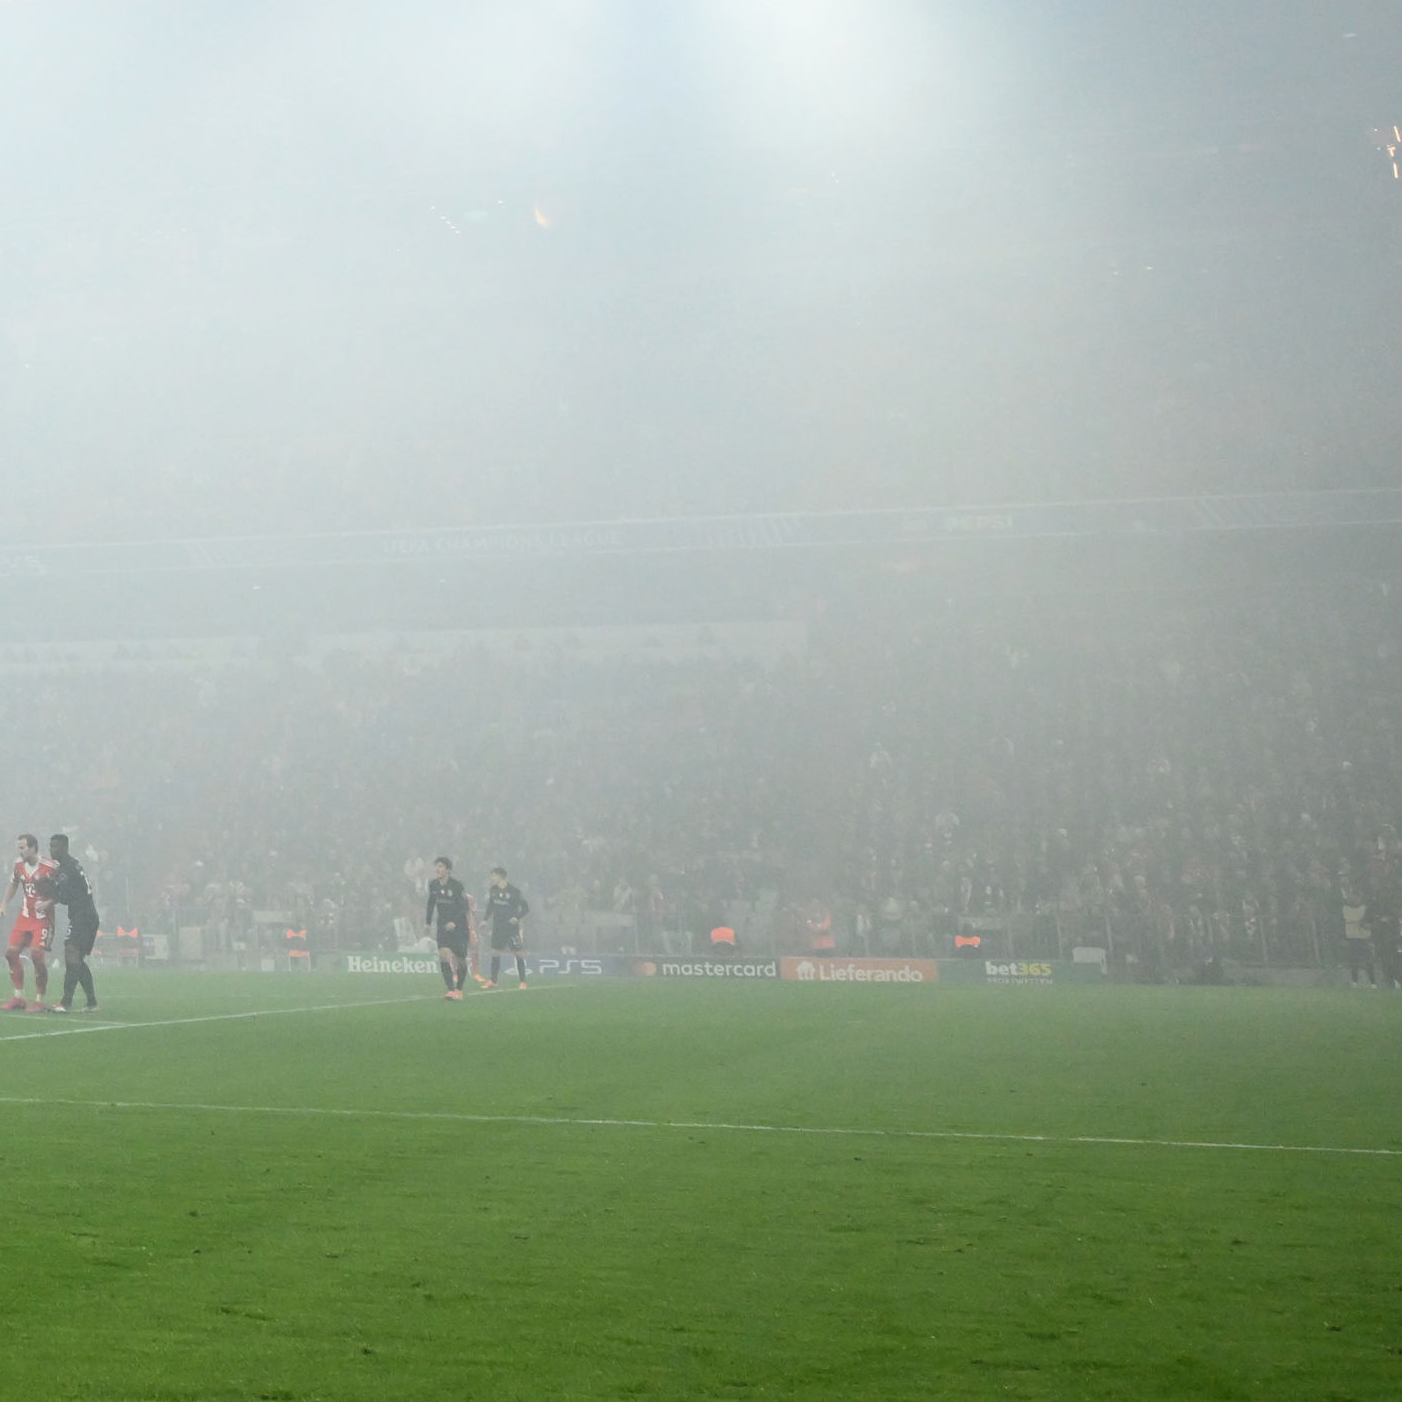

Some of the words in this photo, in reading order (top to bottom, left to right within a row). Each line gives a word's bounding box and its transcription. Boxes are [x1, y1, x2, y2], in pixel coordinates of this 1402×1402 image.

[347, 955, 440, 974] Heineken
[538, 959, 603, 975] PS5
[662, 961, 777, 978] mastercard
[819, 963, 924, 983] Lieferando
[985, 960, 1053, 977] bet365
